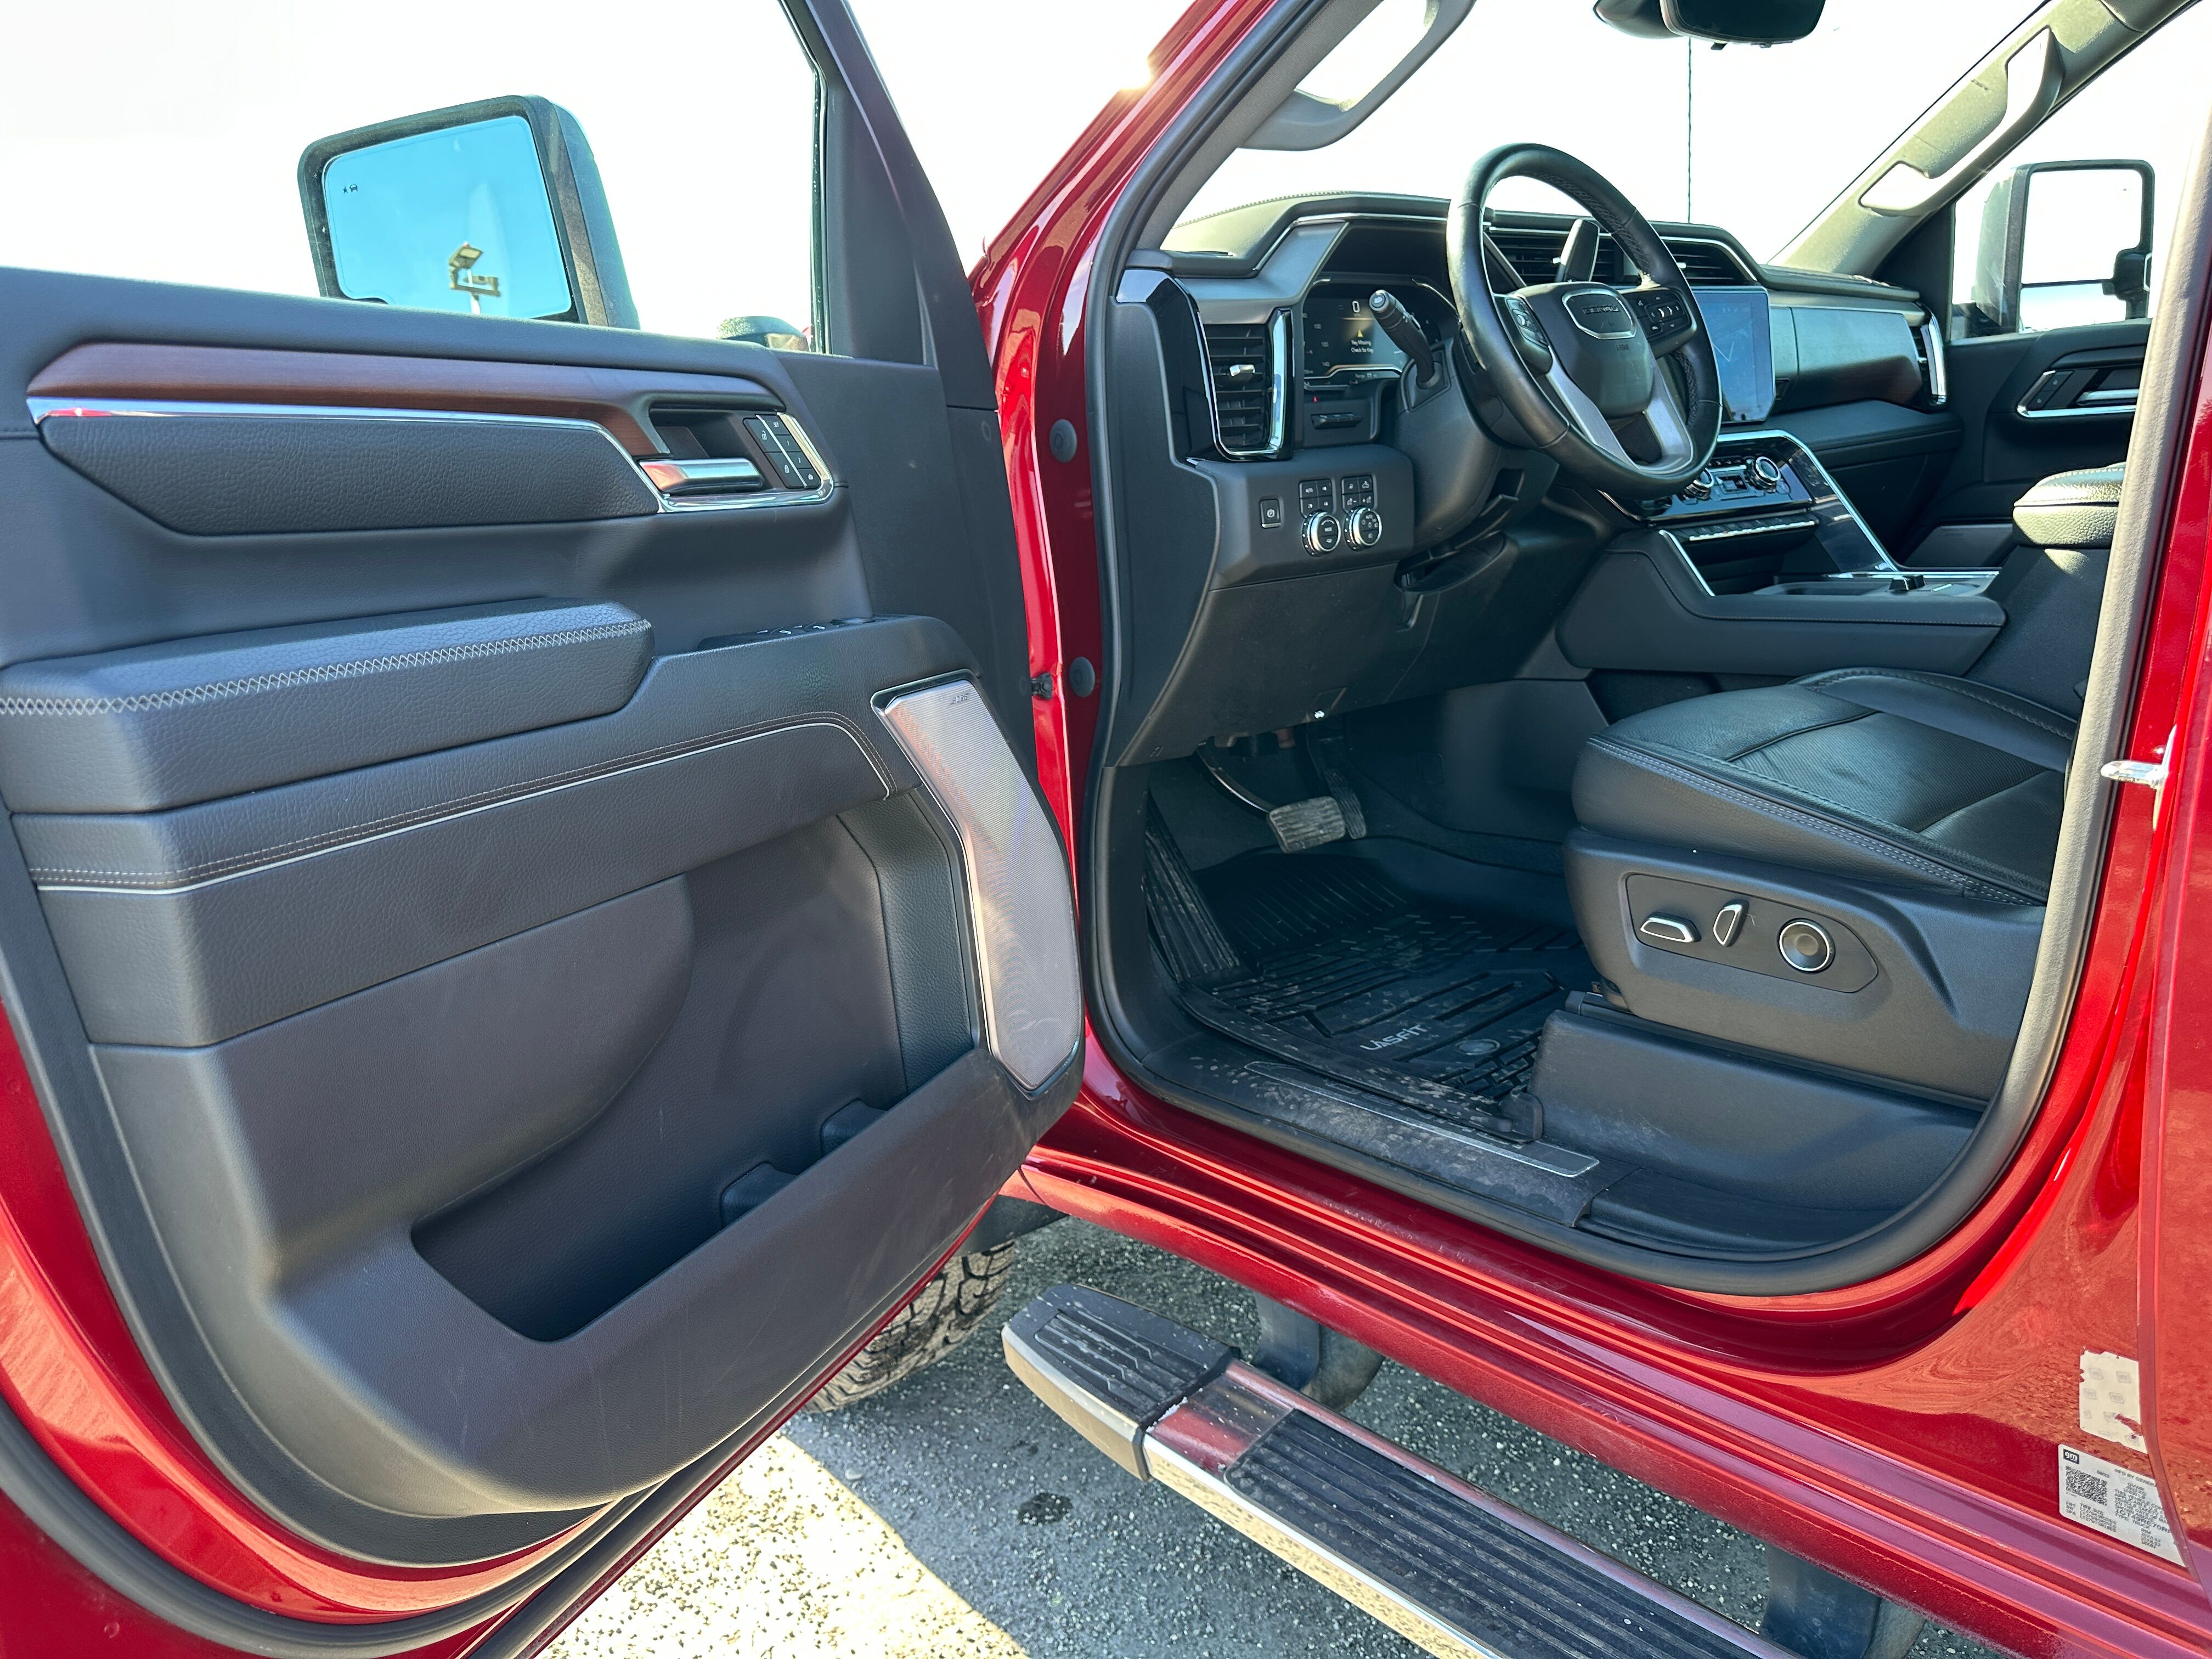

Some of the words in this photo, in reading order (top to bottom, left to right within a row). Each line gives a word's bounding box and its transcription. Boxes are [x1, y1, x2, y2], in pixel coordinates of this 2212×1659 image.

[1352, 301, 1361, 313] 0
[1359, 1024, 1428, 1050] LASFIT
[2064, 1451, 2078, 1461] gm
